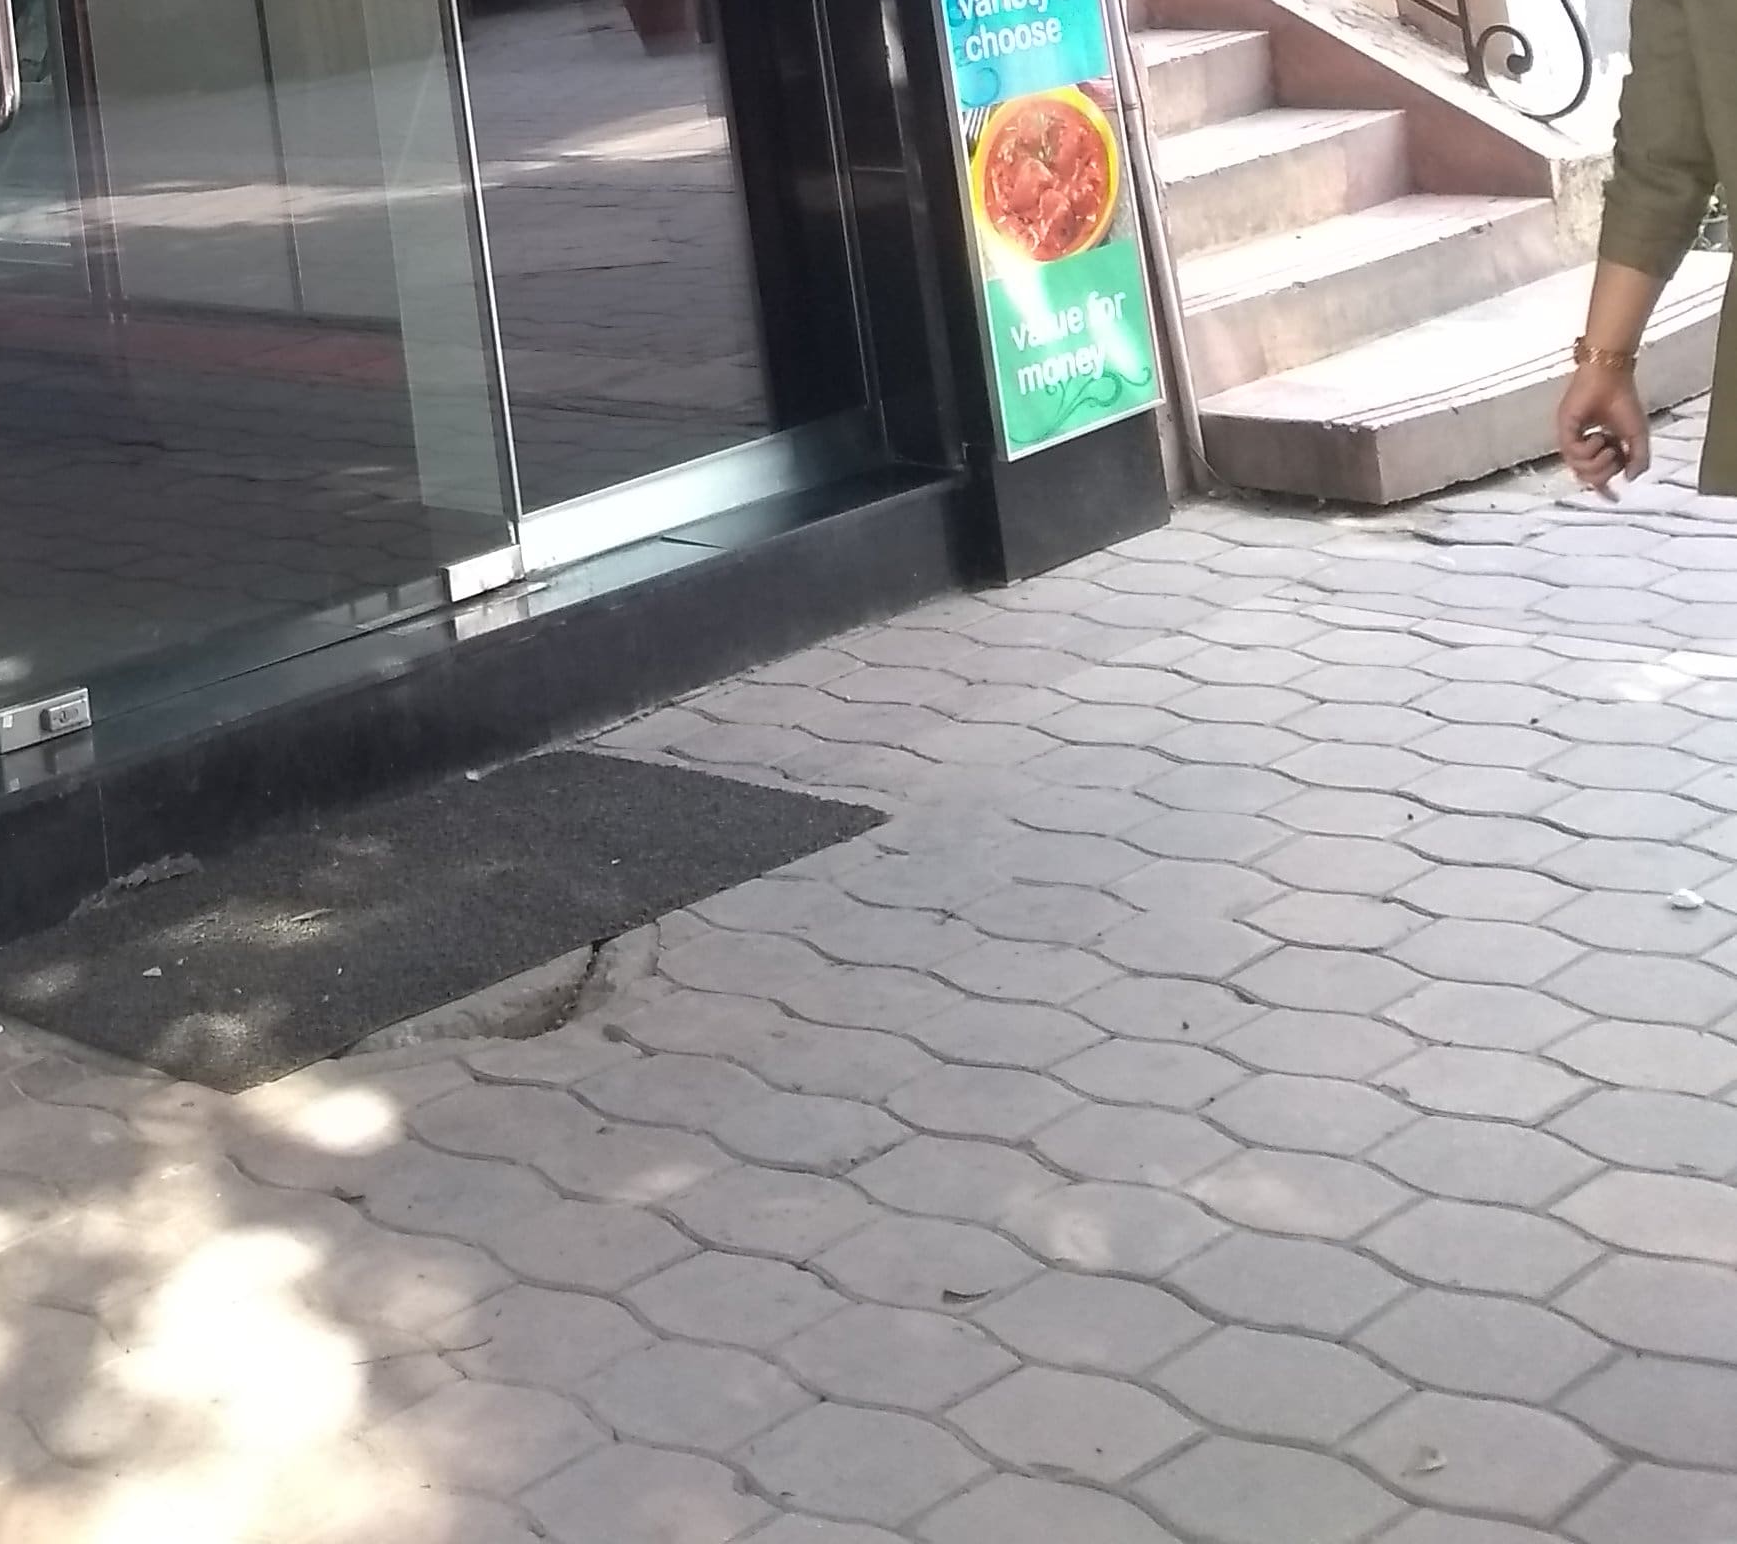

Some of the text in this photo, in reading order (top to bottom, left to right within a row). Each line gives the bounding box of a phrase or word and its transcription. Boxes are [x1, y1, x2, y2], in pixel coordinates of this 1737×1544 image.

[965, 14, 1063, 62] choose
[1010, 289, 1126, 352] vaue for
[1018, 343, 1106, 395] money
